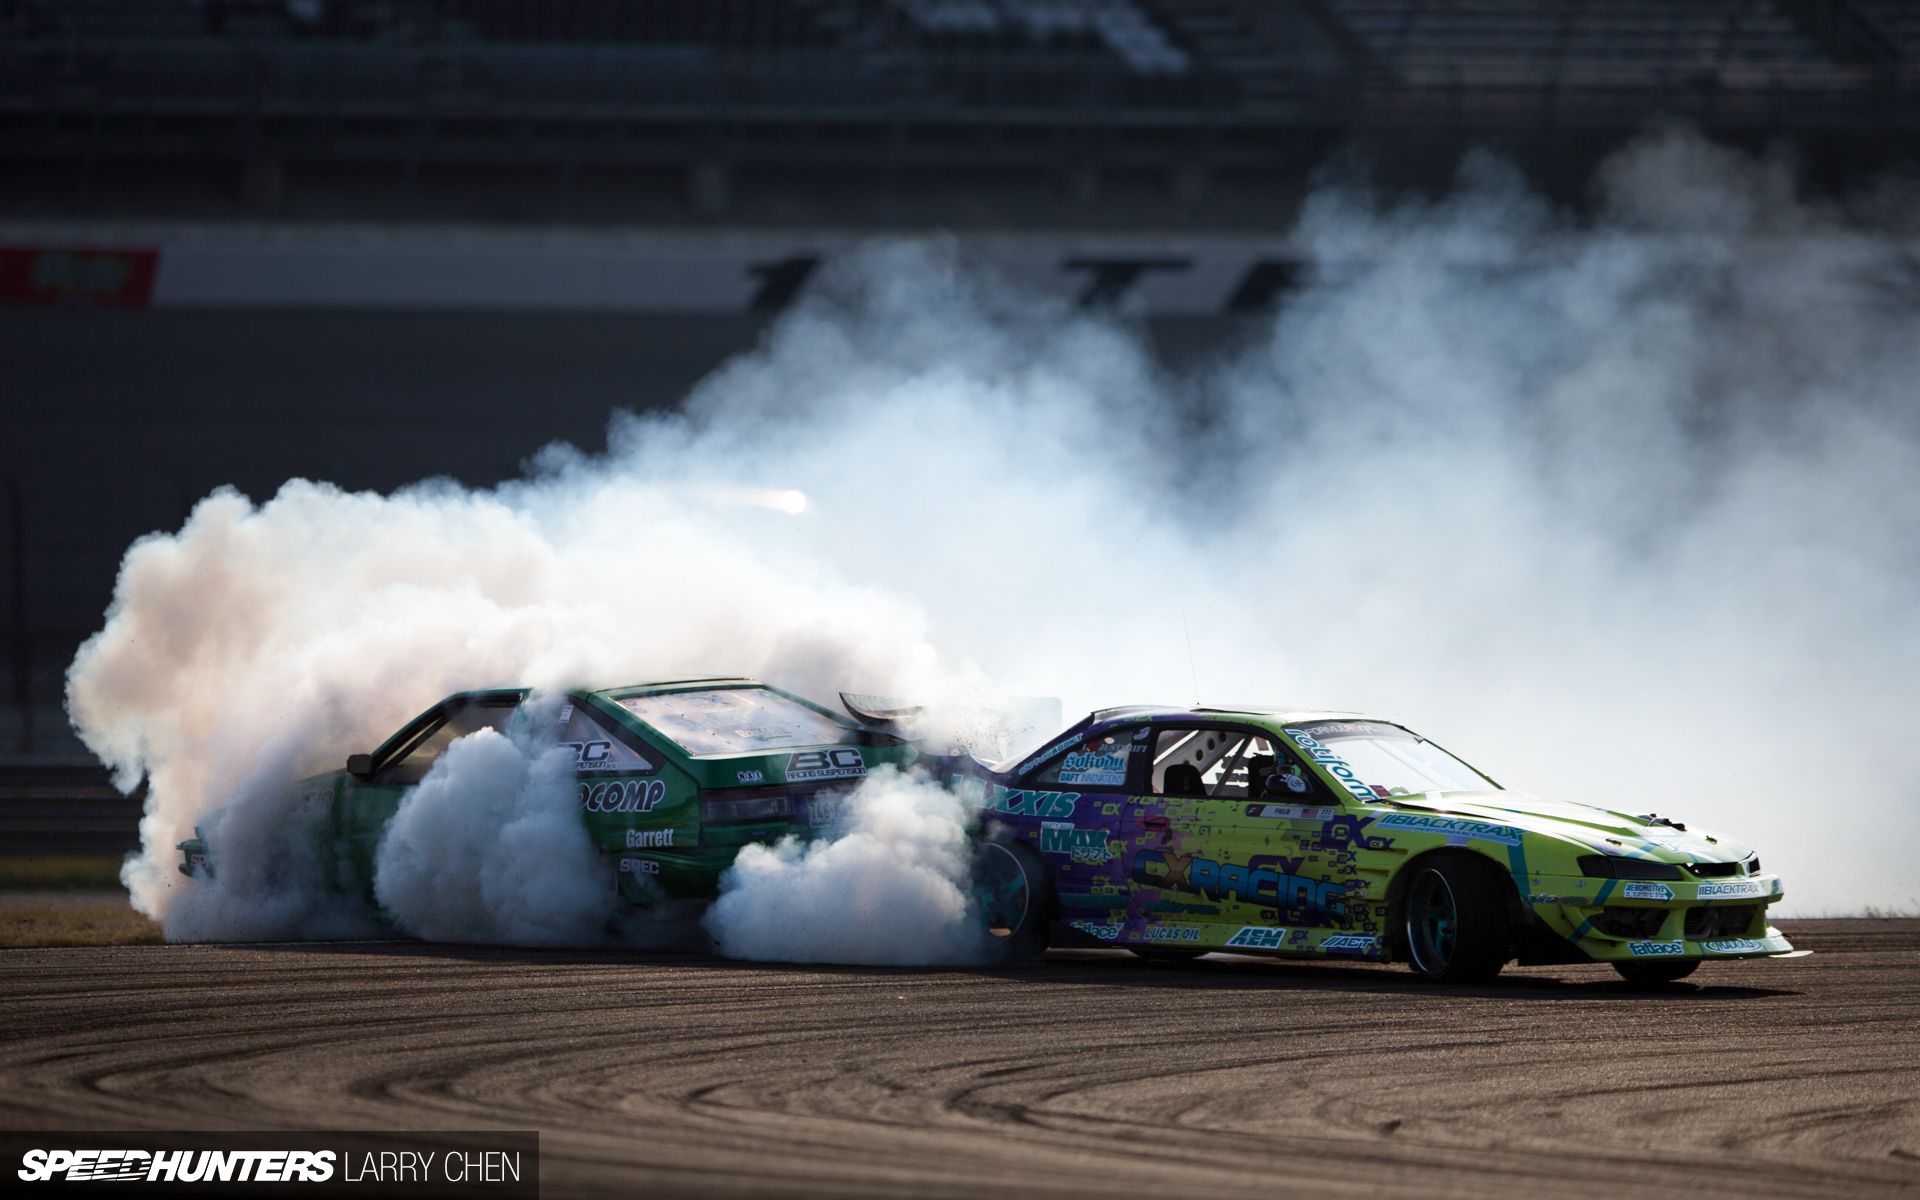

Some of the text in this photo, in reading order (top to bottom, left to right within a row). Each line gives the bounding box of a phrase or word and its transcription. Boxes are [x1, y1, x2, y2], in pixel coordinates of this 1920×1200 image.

[790, 750, 863, 770] BC
[1284, 728, 1382, 801] rotiform
[787, 767, 866, 779] RACING SUSPENSION
[1060, 773, 1080, 783] DAFT
[577, 781, 665, 812] OCOMP
[626, 828, 674, 848] Garrett
[1041, 828, 1109, 853] MAX
[619, 858, 660, 874] SPEC
[1626, 883, 1666, 893] AEROMOTIVE
[1144, 927, 1200, 941] LUCAS OIL
[1229, 929, 1284, 947] AEM
[1628, 941, 1682, 956] fatlace
